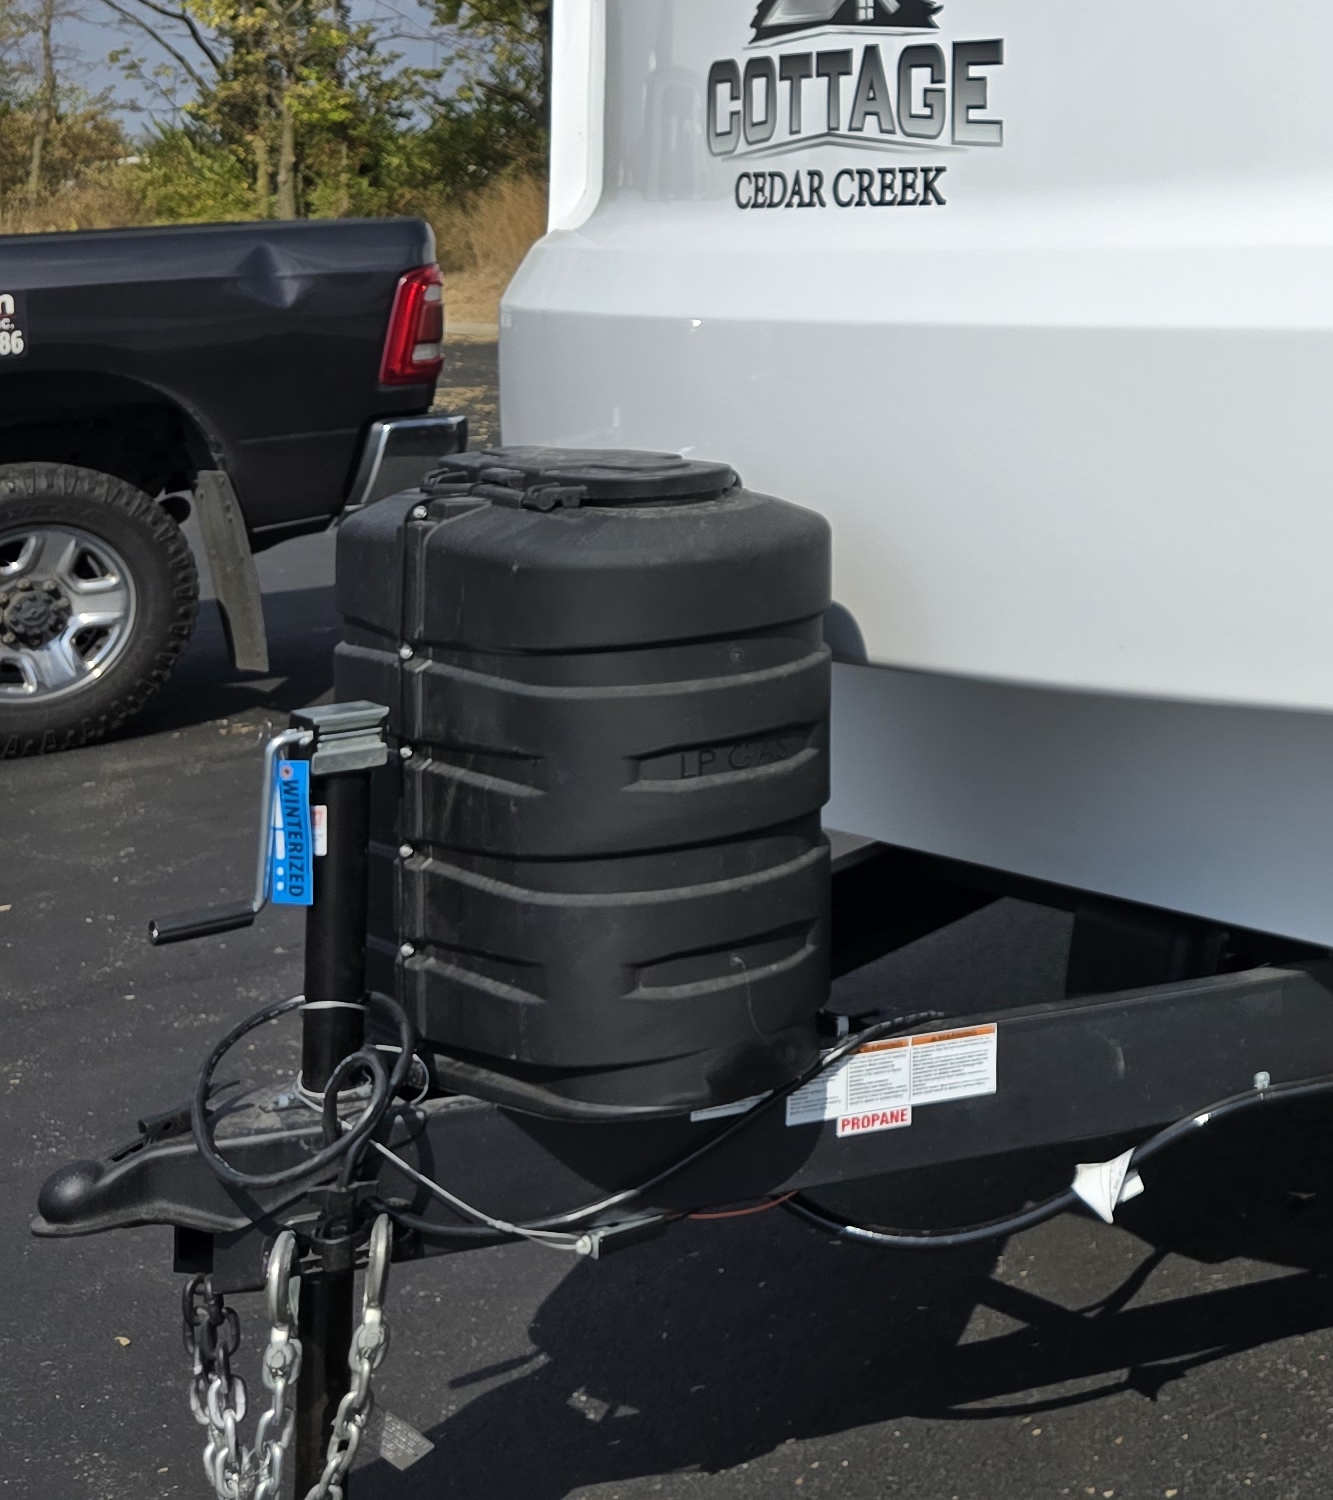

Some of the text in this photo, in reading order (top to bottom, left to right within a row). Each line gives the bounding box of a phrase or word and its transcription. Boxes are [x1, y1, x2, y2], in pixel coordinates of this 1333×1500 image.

[706, 38, 1005, 158] COTTAGE
[734, 165, 948, 210] CEDAR CREEK
[681, 750, 717, 779] LP
[282, 779, 305, 898] WINTERIZED
[840, 1107, 909, 1133] PROPANE
